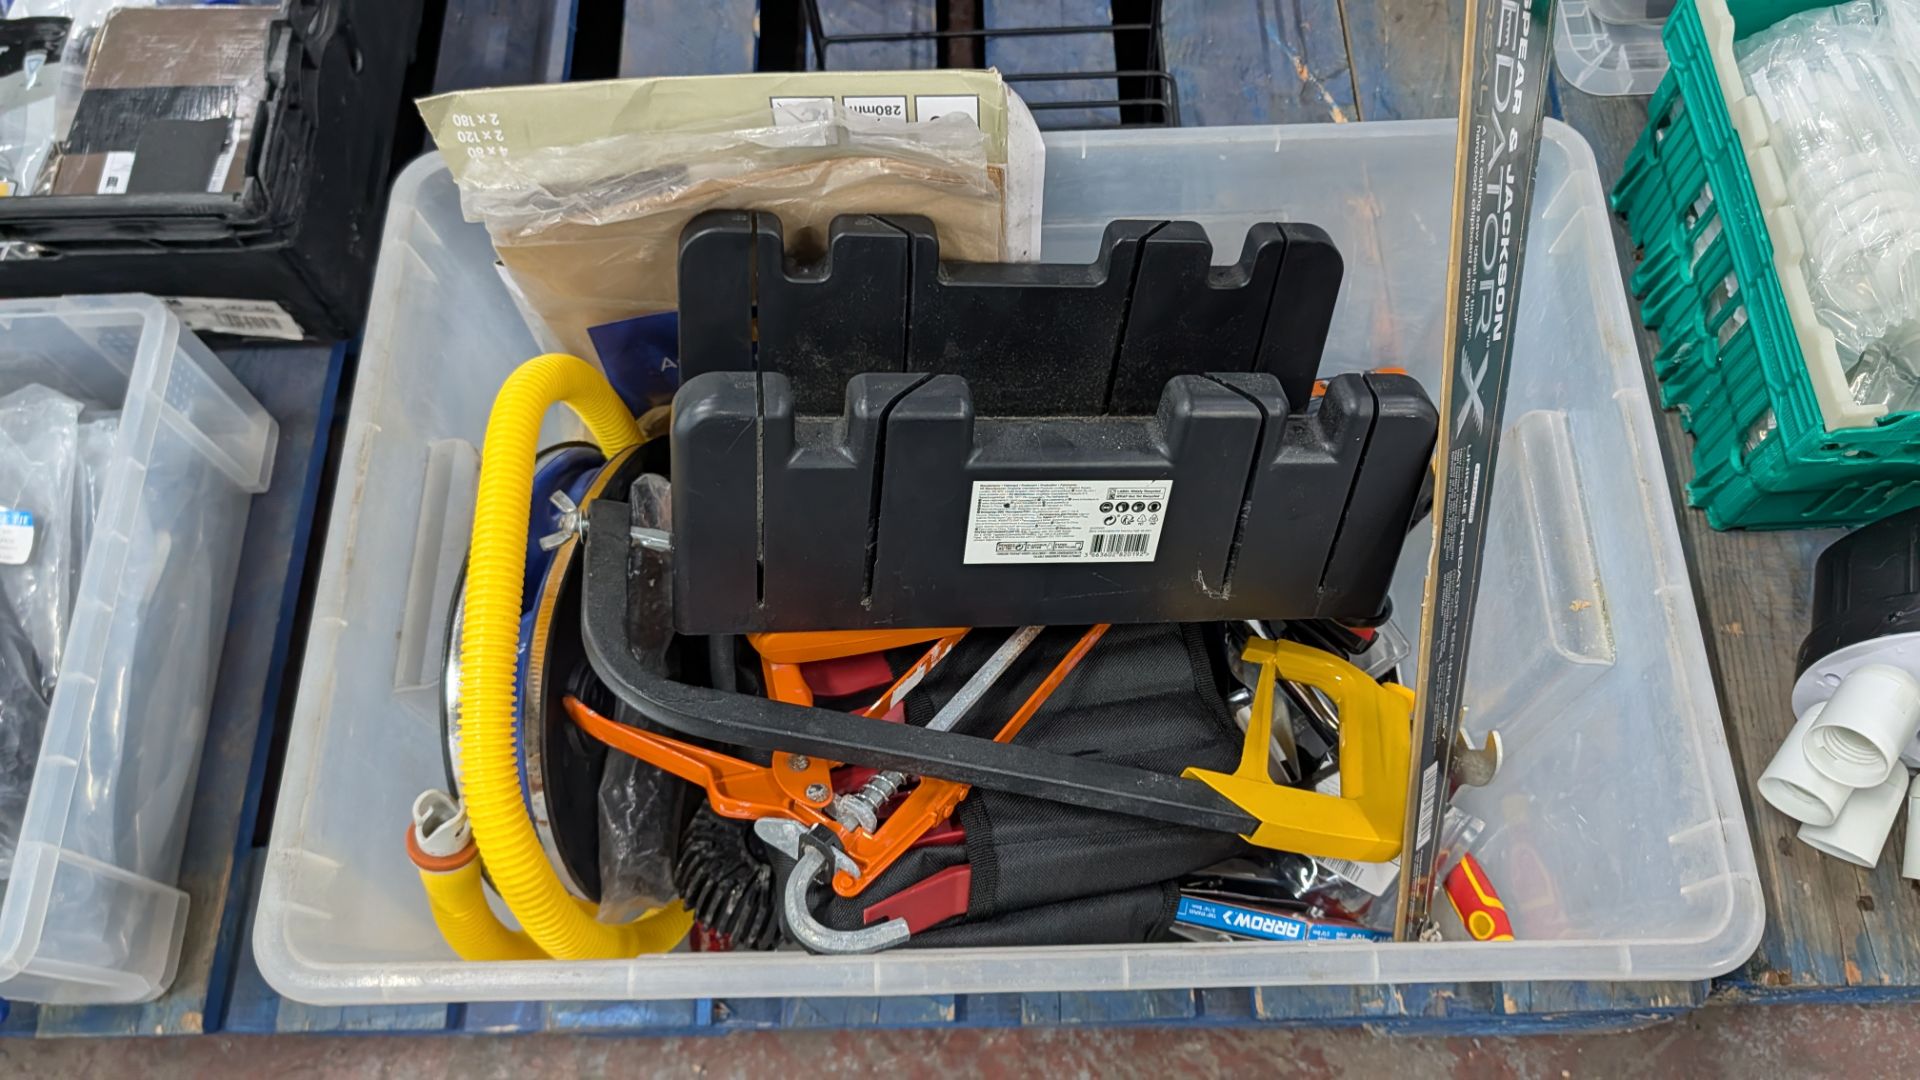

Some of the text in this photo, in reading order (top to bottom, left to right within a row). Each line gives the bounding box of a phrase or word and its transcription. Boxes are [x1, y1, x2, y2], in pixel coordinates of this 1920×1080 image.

[452, 113, 476, 127] 180
[489, 113, 500, 126] 2
[457, 130, 481, 143] 120
[494, 129, 505, 142] 2
[1509, 127, 1518, 152] &
[1476, 167, 1484, 212] cutting
[1467, 199, 1476, 264] chipboard
[1493, 163, 1515, 341] JACKSON
[1462, 443, 1473, 515] UNIQUE
[1453, 518, 1466, 617] PREDATOR
[1234, 912, 1300, 938] ARROW
